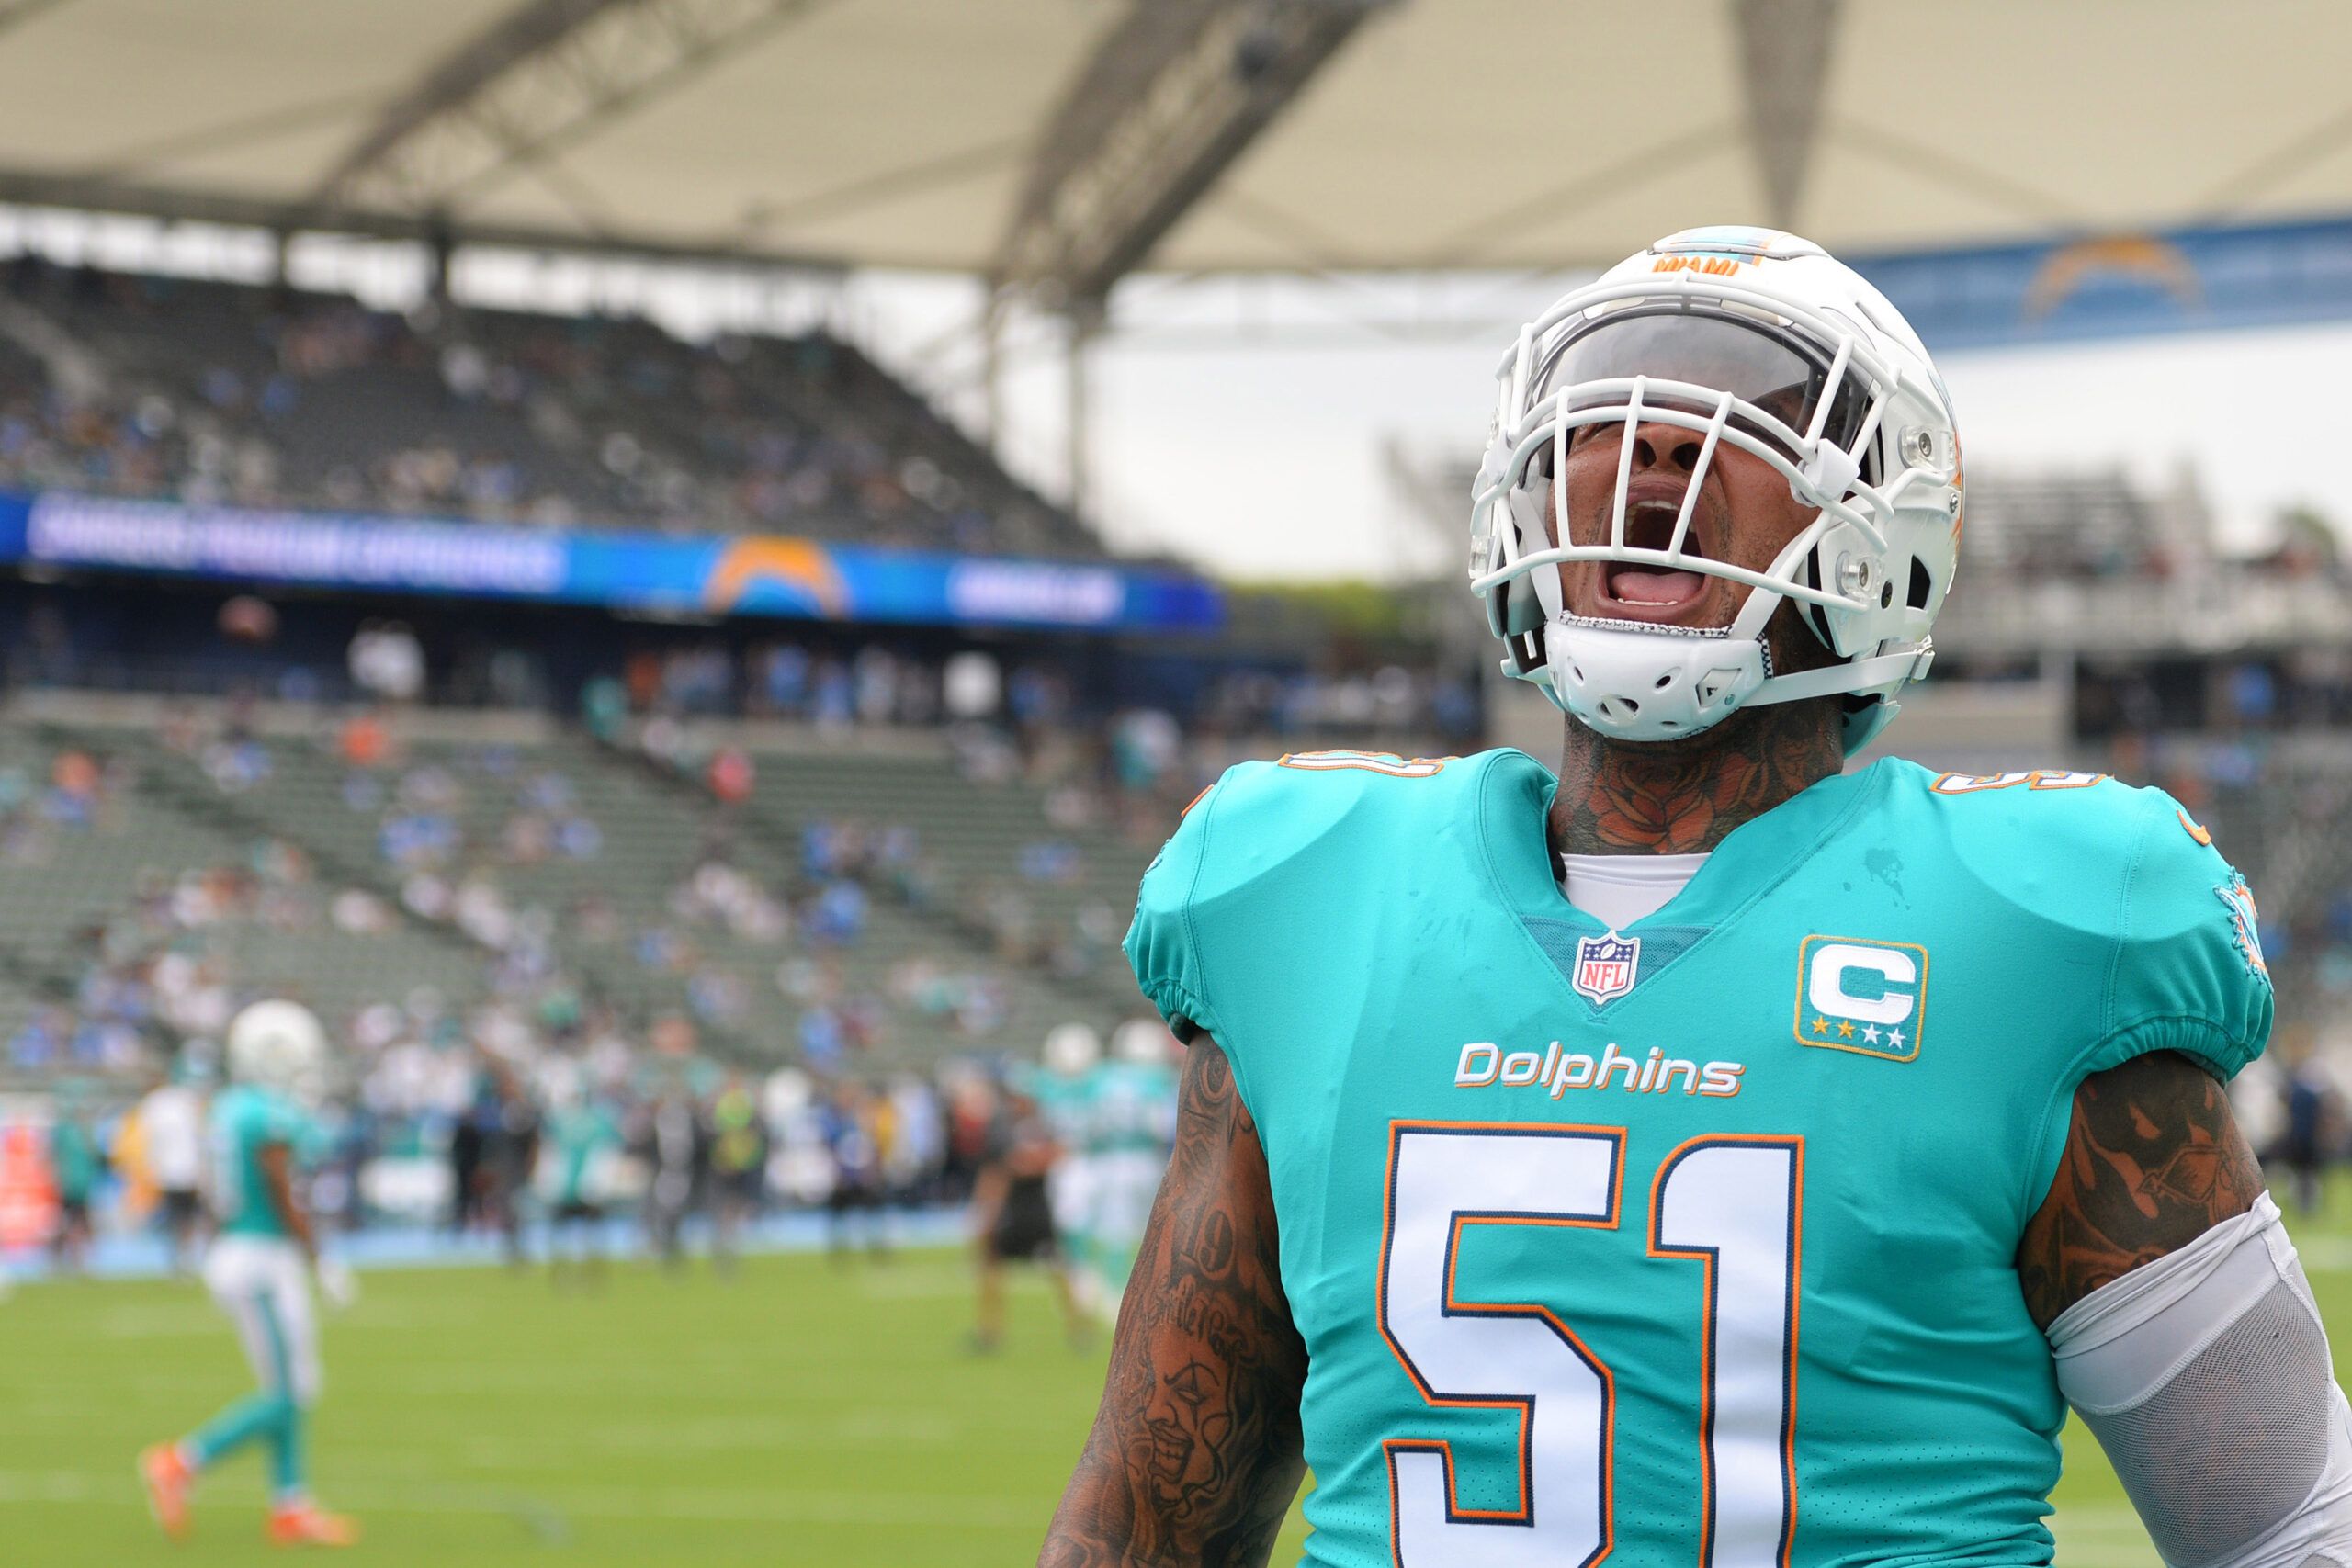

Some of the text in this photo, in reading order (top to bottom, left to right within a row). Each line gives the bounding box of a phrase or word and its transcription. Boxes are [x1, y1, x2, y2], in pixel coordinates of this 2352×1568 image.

[1583, 963, 1625, 990] NFL
[1808, 943, 1917, 1025] C
[1454, 1041, 1746, 1100] Dolphins
[1377, 1118, 1804, 1568] 51
